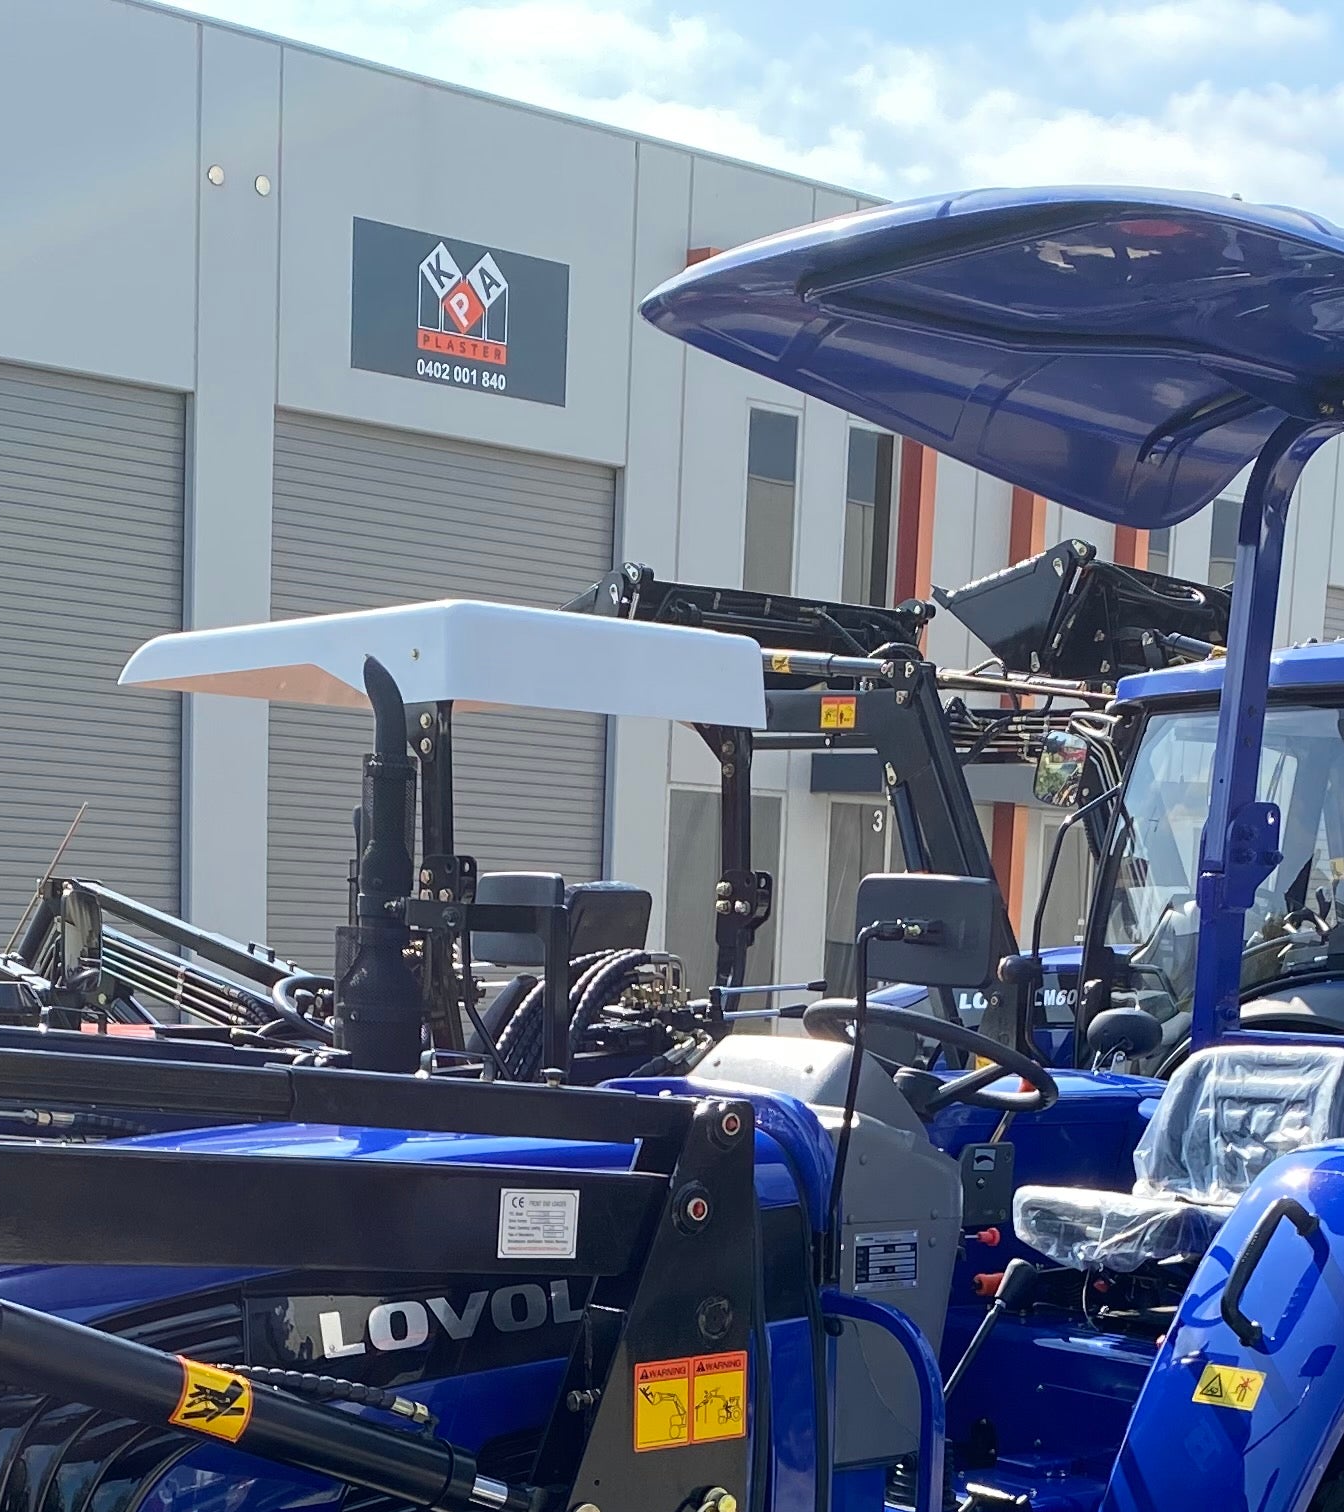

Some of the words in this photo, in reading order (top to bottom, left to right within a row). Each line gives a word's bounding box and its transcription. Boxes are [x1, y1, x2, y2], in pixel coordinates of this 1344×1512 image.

[422, 334, 502, 360] PLASTER
[416, 358, 450, 380] 0402
[453, 367, 477, 385] 001
[481, 371, 506, 390] 840
[872, 809, 883, 832] 3
[319, 1279, 586, 1359] LOVOL
[649, 1366, 686, 1378] WARNING
[705, 1359, 741, 1370] WARNING
